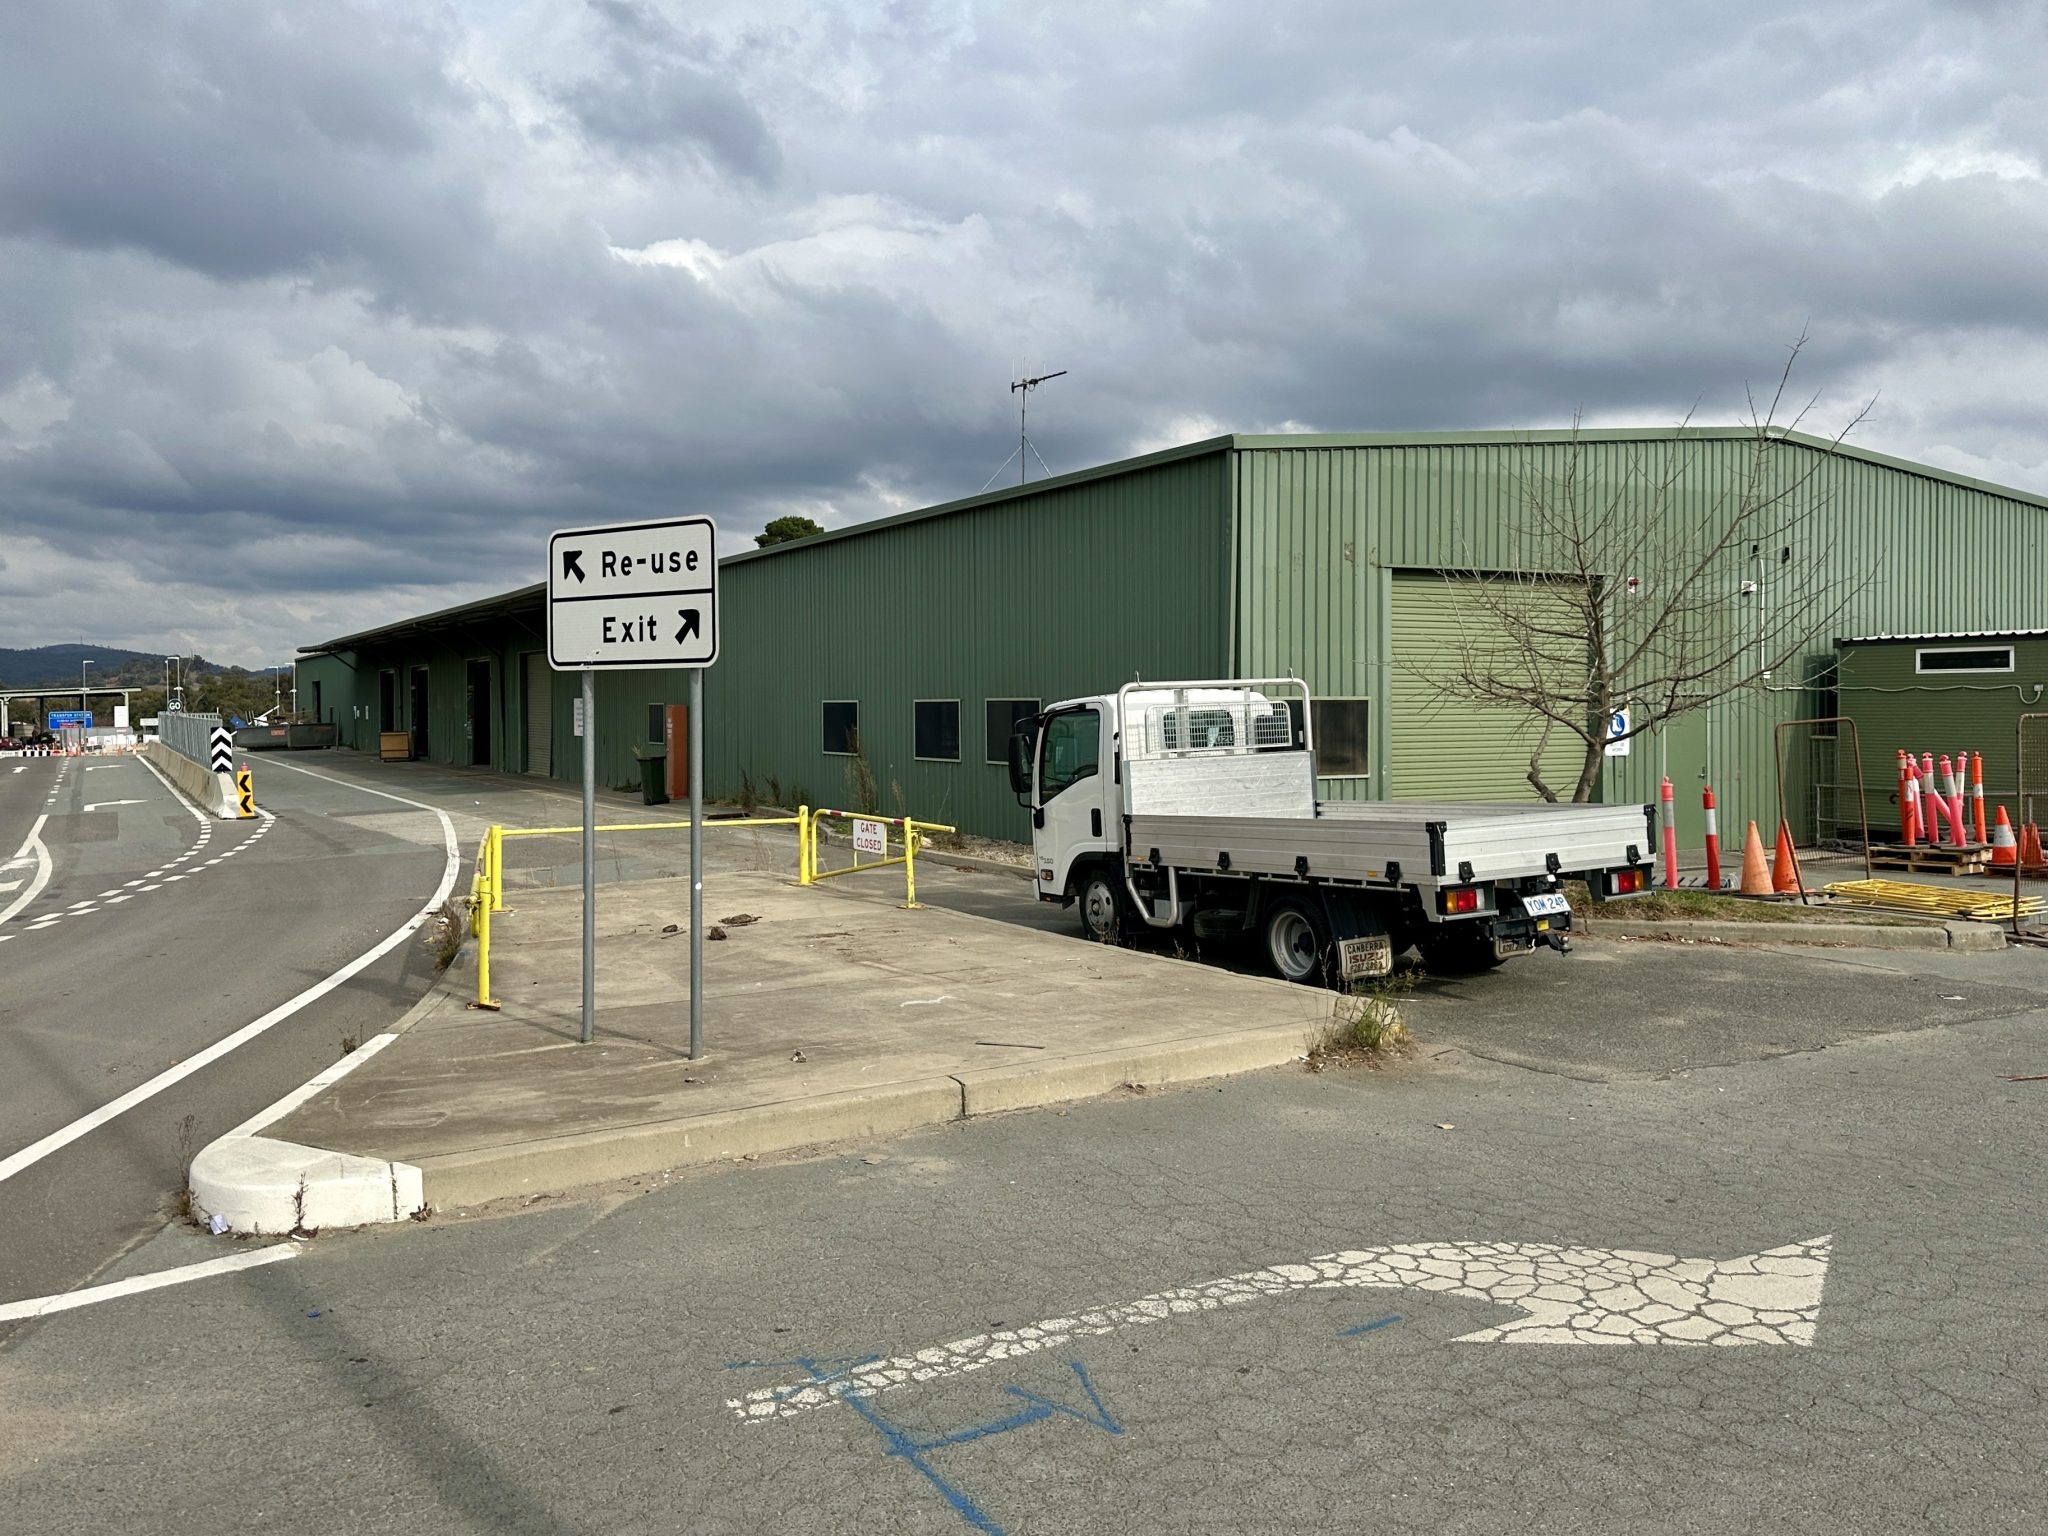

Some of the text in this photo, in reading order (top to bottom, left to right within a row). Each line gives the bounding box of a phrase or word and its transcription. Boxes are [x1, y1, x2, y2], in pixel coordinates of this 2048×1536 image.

[602, 550, 699, 578] Re-use
[602, 615, 657, 643] Exit
[169, 702, 181, 710] GO
[861, 822, 877, 834] GATE
[857, 837, 881, 851] CLOSED
[1347, 941, 1385, 955] CANBERRA
[1349, 951, 1384, 965] ISUZU
